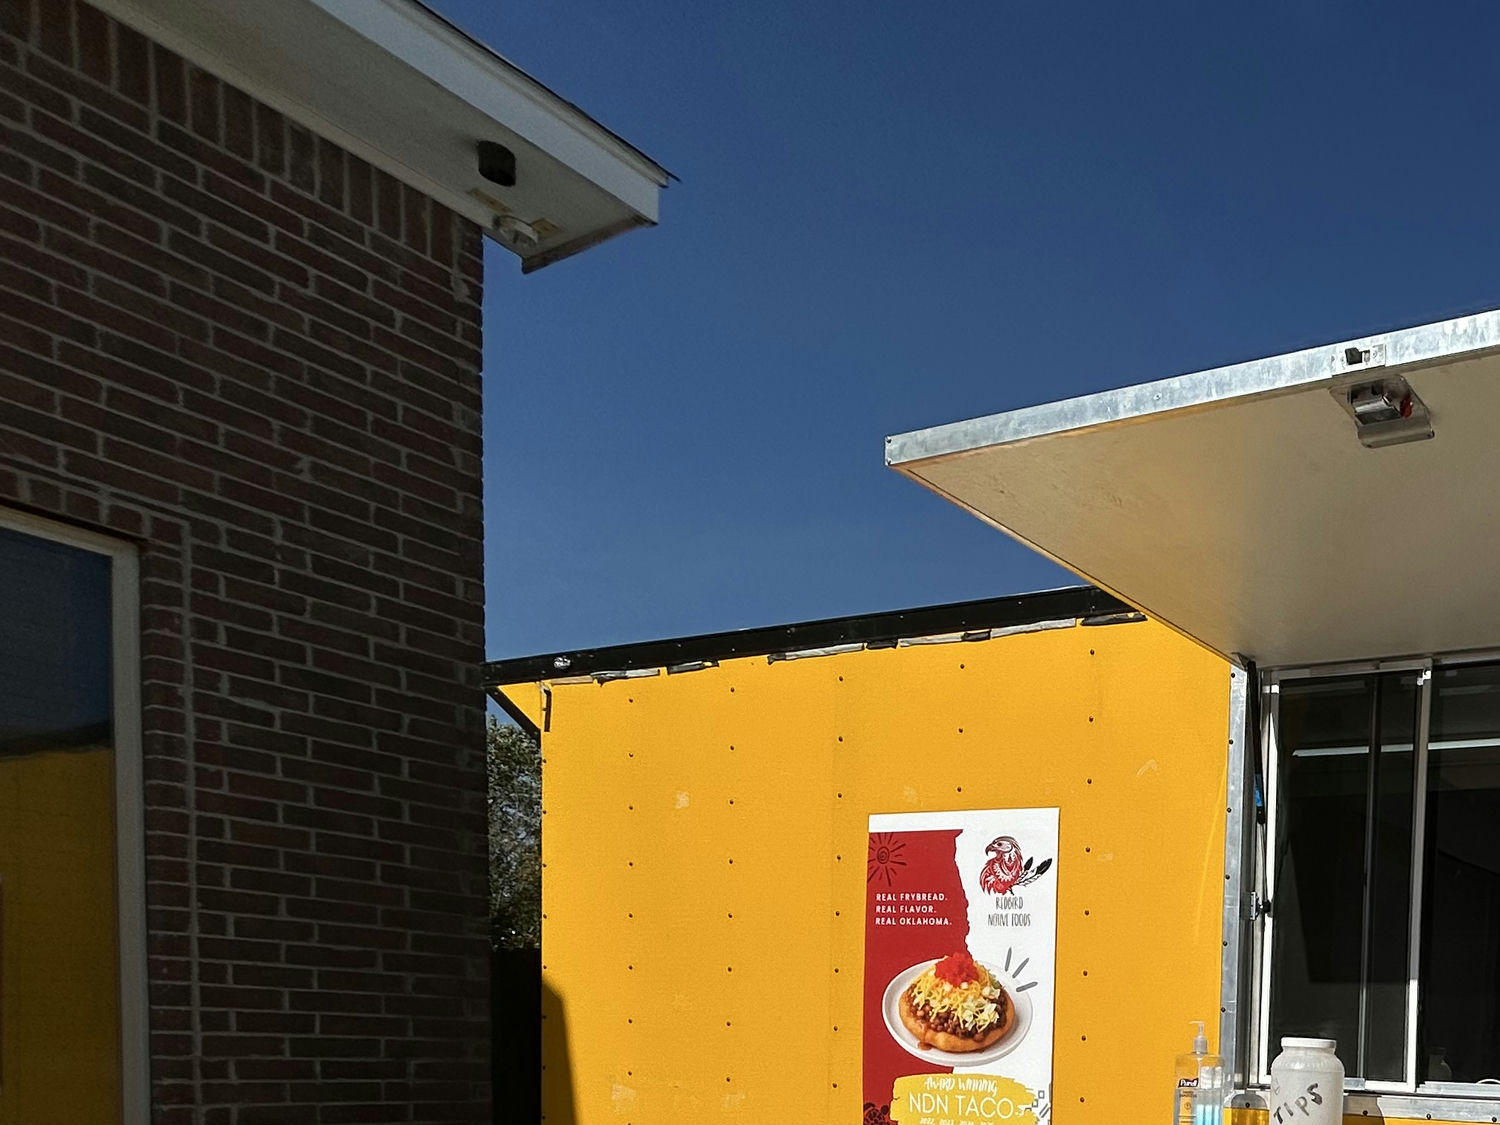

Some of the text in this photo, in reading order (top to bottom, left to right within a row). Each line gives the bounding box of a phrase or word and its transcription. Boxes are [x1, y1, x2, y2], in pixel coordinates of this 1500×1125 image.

[876, 893, 948, 901] REAL FRYBREAD.
[876, 905, 937, 913] REAL FLAVOR.
[876, 917, 952, 925] REAL OKLAHOMA.
[909, 1092, 1014, 1119] NDN TACO
[1274, 1084, 1322, 1124] TIPS
